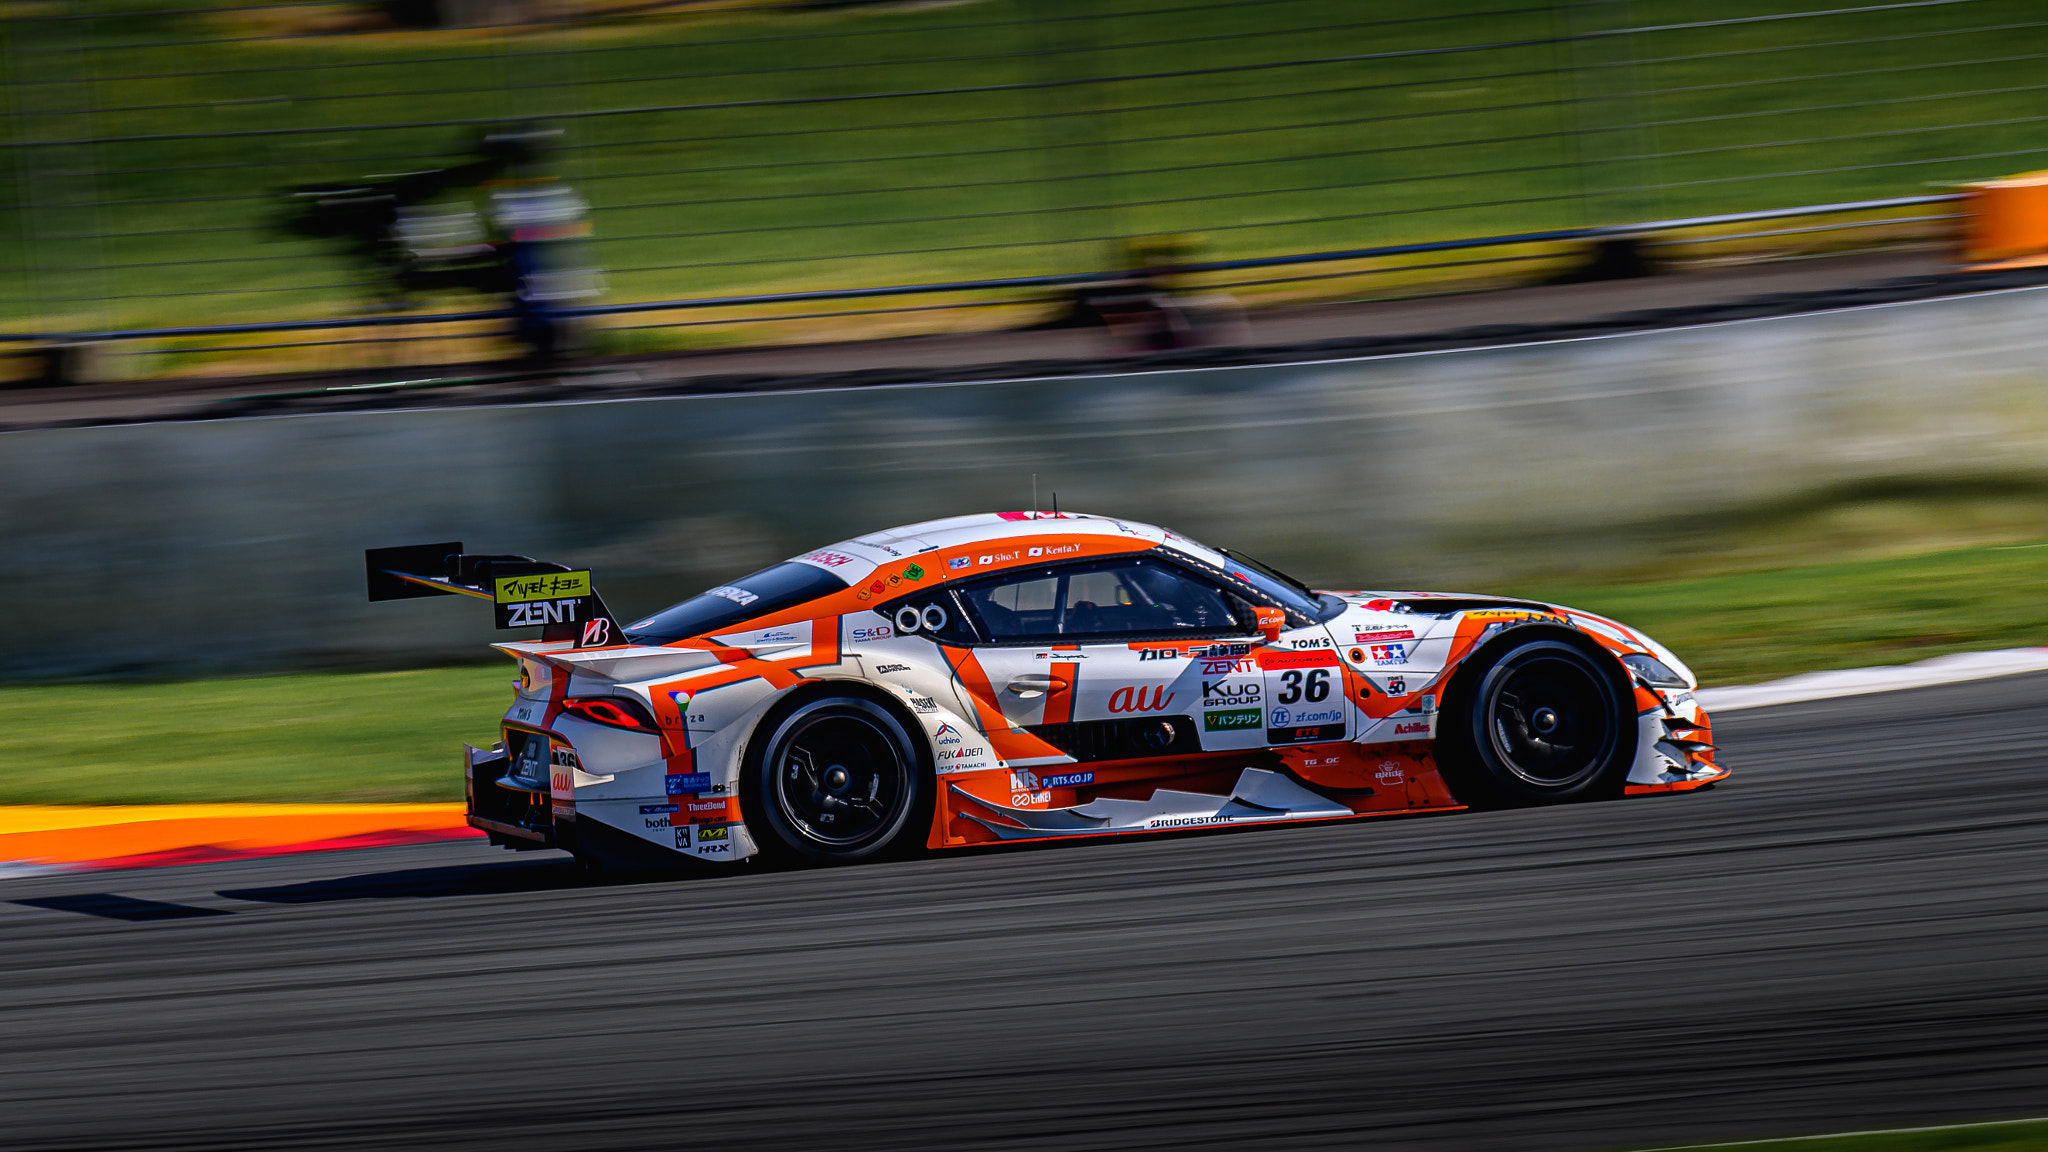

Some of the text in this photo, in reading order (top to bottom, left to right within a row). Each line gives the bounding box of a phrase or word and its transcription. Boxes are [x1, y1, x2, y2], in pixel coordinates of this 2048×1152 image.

[1045, 544, 1081, 555] Kenta.Y
[994, 551, 1020, 562] Sho.T
[507, 599, 577, 627] ZENT
[852, 626, 891, 639] S&D
[1291, 636, 1330, 650] TOM'S
[1200, 659, 1254, 676] ZENT
[1278, 668, 1330, 705] 36
[1388, 680, 1406, 694] 50
[1108, 685, 1175, 713] au
[1203, 696, 1261, 707] GROUP
[1218, 714, 1260, 726] バンテリン
[1296, 709, 1342, 723] zf.com/jp
[1295, 727, 1320, 737] ETS
[1394, 721, 1431, 735] Achilles
[938, 736, 961, 745] uchino
[520, 759, 539, 777] ZENT
[961, 762, 987, 770] TAMACHI
[1375, 770, 1404, 779] BRIDE
[552, 772, 571, 792] au
[688, 801, 726, 812] ThreeBond
[645, 817, 671, 829] both
[1150, 815, 1234, 829] BRIDGESTONE
[698, 843, 730, 855] HRX
